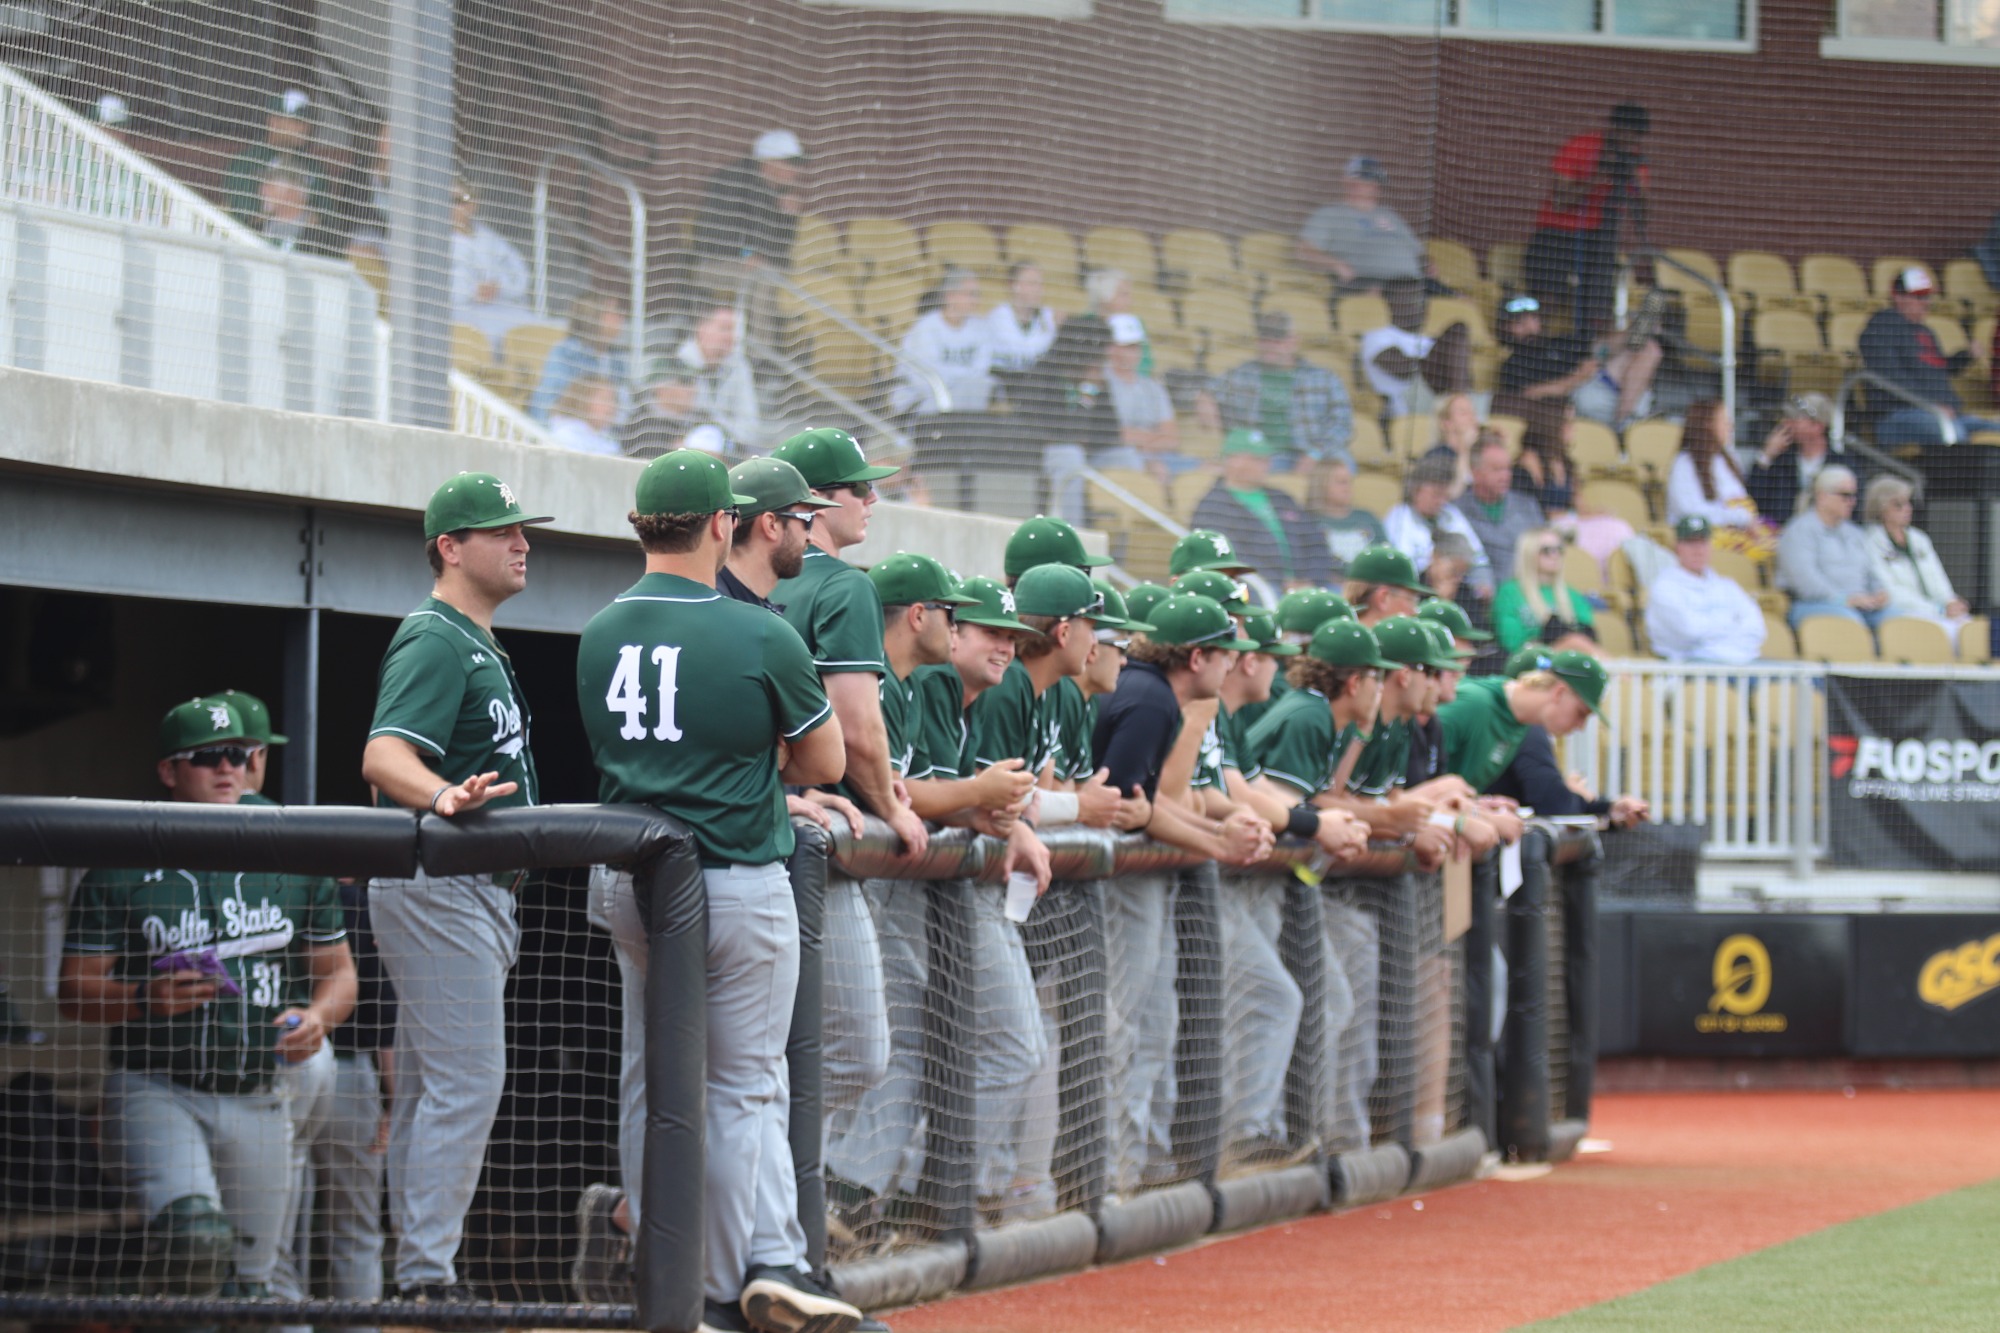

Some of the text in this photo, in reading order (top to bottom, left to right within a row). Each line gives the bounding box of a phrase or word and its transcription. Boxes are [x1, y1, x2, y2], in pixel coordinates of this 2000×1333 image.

[605, 645, 683, 742] 41
[142, 897, 291, 955] Delta State
[252, 961, 282, 1008] 31
